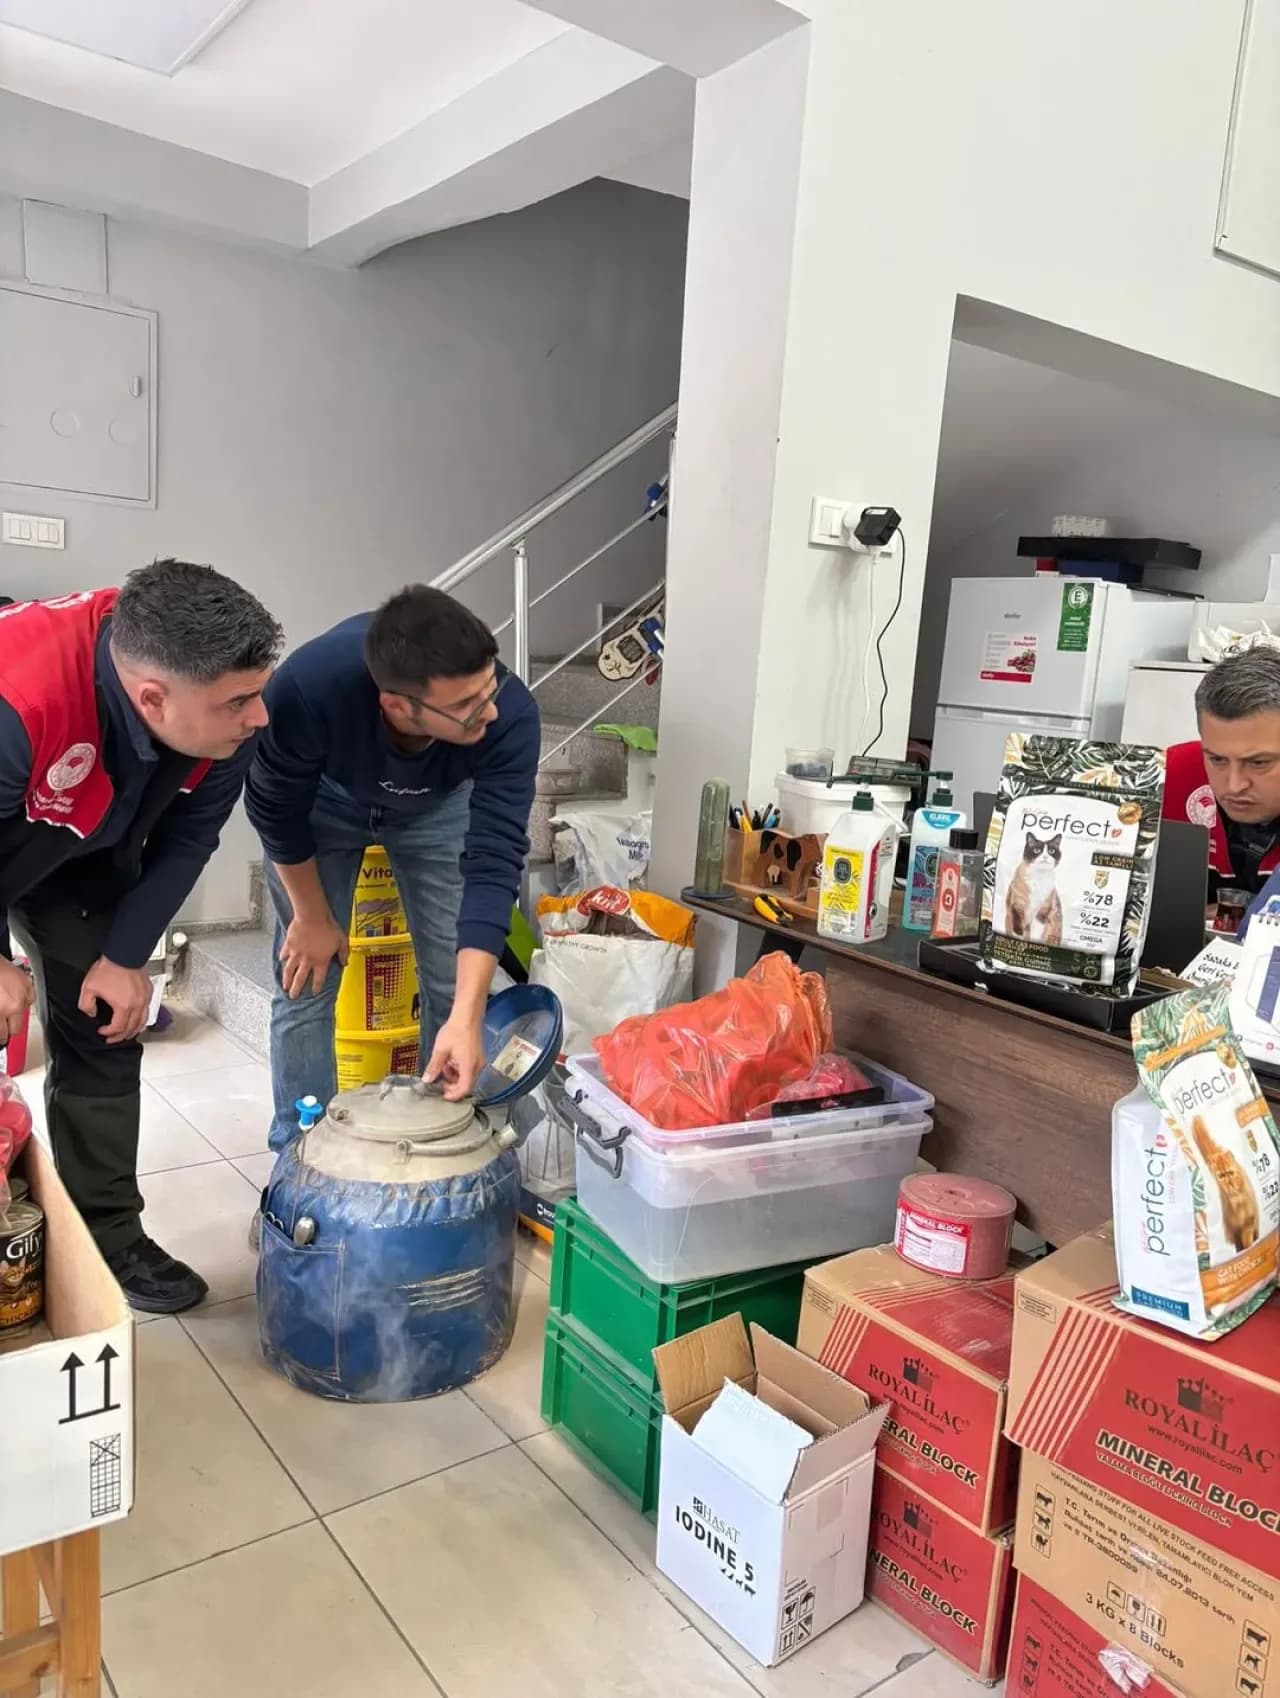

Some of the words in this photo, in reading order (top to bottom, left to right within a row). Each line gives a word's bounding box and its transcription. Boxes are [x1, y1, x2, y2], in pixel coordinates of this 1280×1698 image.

[1074, 590, 1081, 601] E
[1021, 814, 1111, 838] perfect
[1083, 890, 1113, 906] %78
[1080, 912, 1110, 928] %22
[1080, 935, 1103, 944] OMEGA
[1174, 1068, 1232, 1115] perfect
[1141, 1147, 1171, 1256] perfect
[920, 1442, 979, 1487] BLOCK
[1097, 1430, 1202, 1494] MINERAL
[675, 1505, 737, 1570] IODINE
[744, 1562, 754, 1582] 5
[703, 1503, 741, 1544] HASAT
[1171, 1532, 1196, 1553] STOCK
[869, 1549, 918, 1592] NERAL
[920, 1584, 978, 1634] BLOCK
[1085, 1592, 1093, 1604] 3
[1096, 1599, 1115, 1620] KG
[1129, 1623, 1137, 1635] 8
[1140, 1630, 1185, 1669] Blocks
